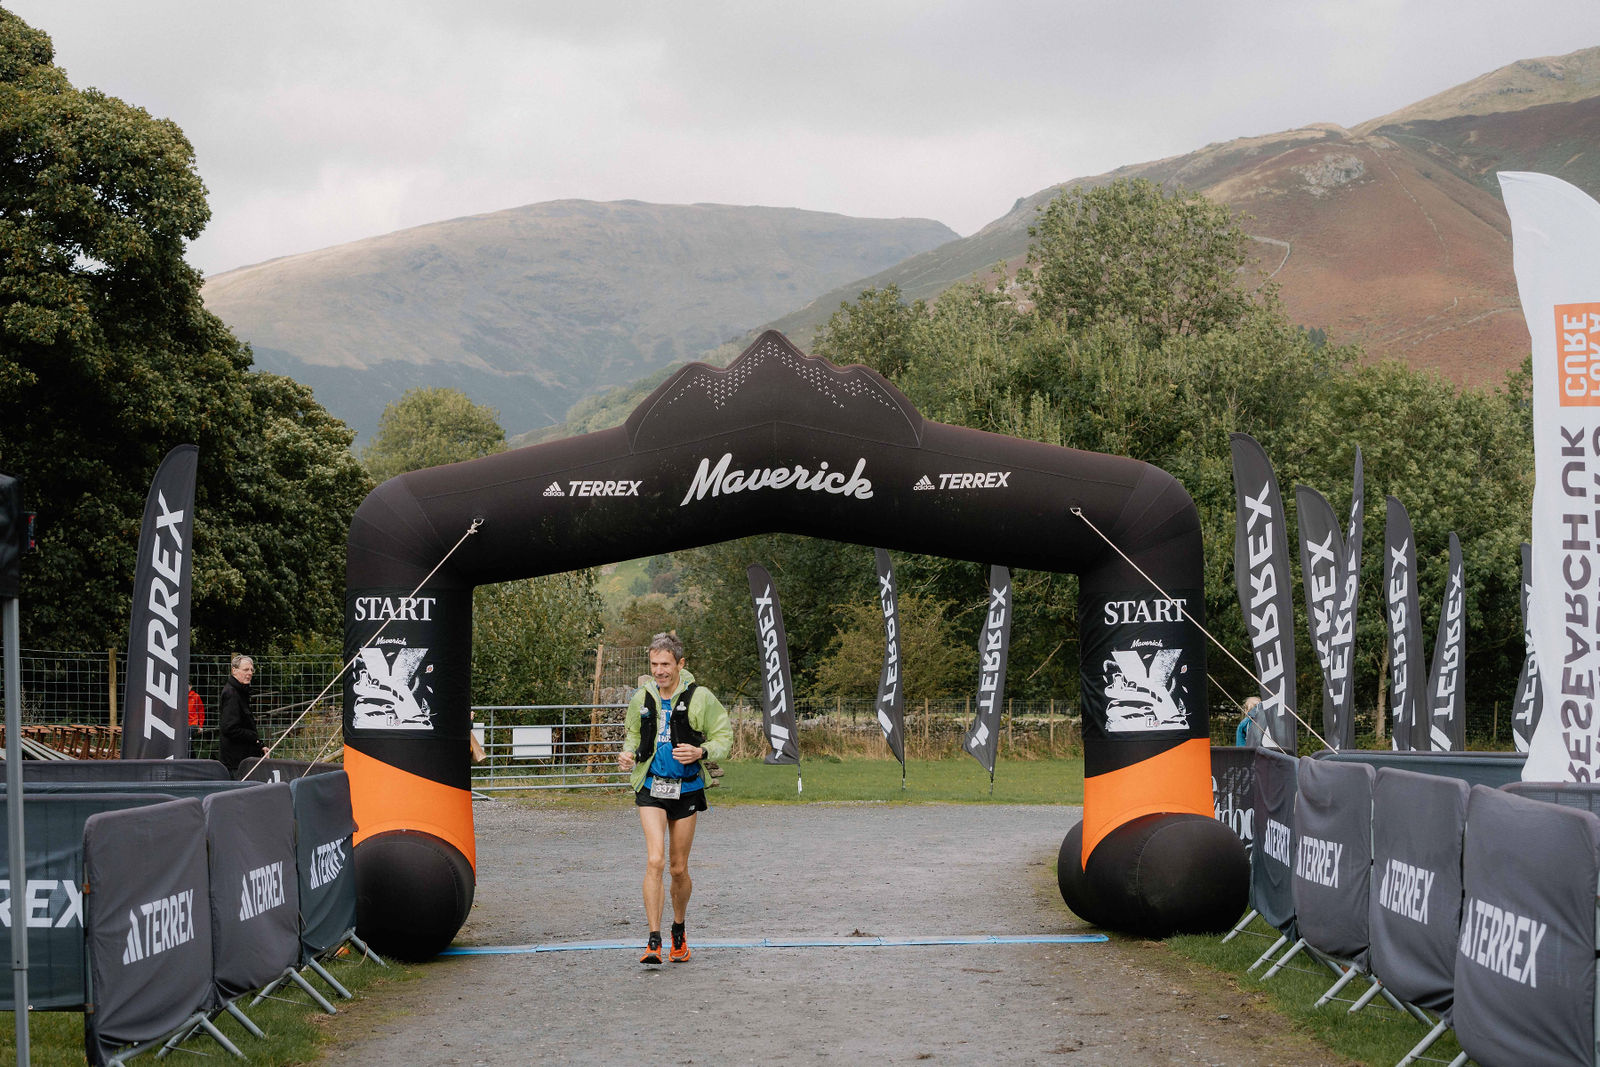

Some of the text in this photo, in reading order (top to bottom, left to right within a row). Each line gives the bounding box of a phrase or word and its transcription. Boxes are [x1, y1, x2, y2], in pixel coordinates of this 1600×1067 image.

[568, 480, 643, 497] TERREX
[680, 452, 874, 507] Maverick
[938, 471, 1012, 490] TERREX
[144, 489, 184, 740] TERREX
[354, 597, 436, 621] START
[1104, 599, 1187, 626] START
[375, 636, 407, 647] Maverick
[1131, 639, 1163, 649] Maverick
[249, 861, 285, 914] TERREX
[1302, 835, 1343, 889] TERREX
[1387, 859, 1435, 925] TERREX
[140, 889, 194, 958] TERREX
[1471, 899, 1547, 989] TERREX
